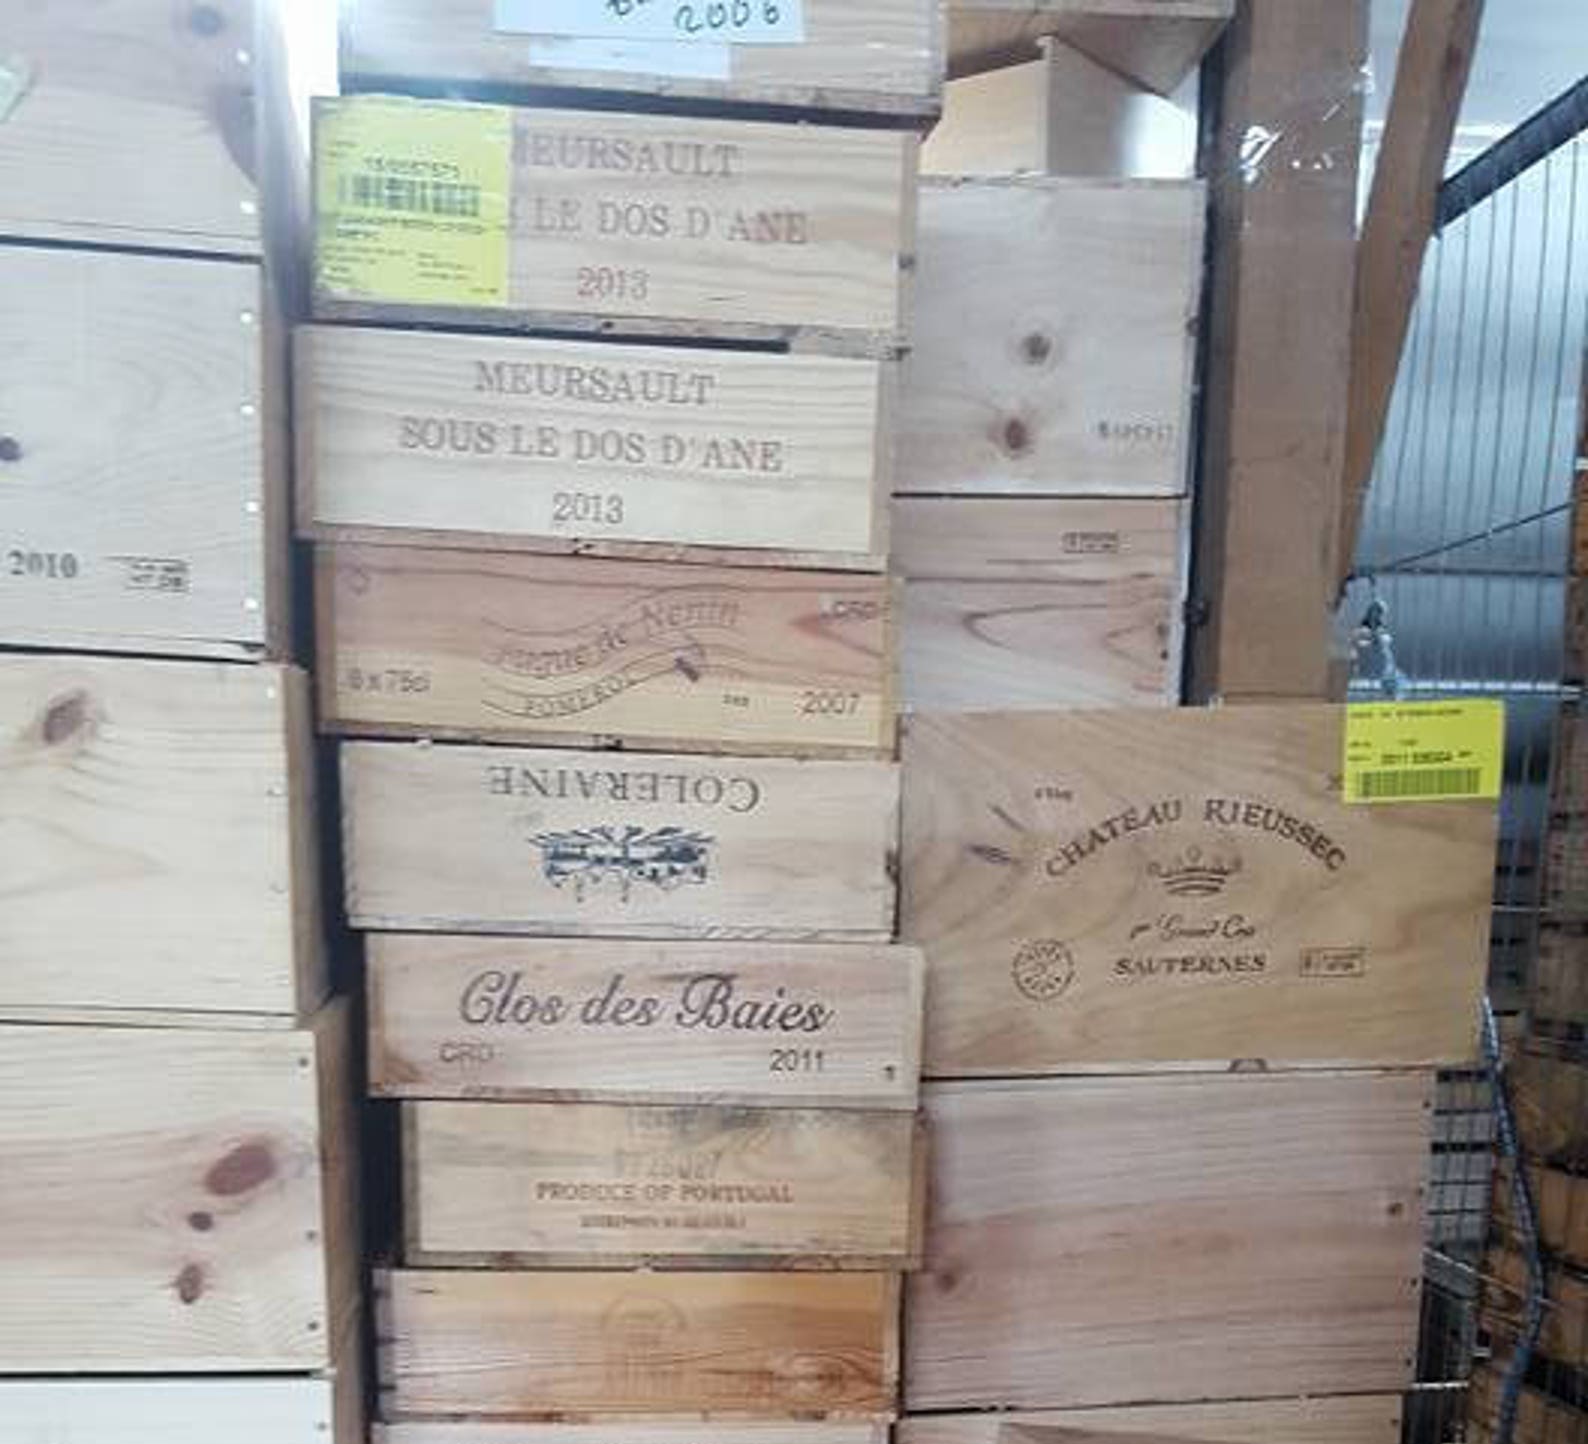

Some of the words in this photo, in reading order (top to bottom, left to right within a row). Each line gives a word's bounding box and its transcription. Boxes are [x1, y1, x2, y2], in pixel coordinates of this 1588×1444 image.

[533, 197, 582, 232] LE
[599, 202, 671, 238] DOS
[577, 266, 650, 301] 2013
[475, 359, 716, 406] MEURSAULT
[401, 416, 498, 453] SOUS
[506, 424, 560, 458] LE
[572, 428, 647, 465] DOS
[659, 434, 783, 473] D'ANE
[552, 490, 625, 525] 2013
[7, 549, 79, 579] 2010
[802, 689, 861, 714] 2007
[485, 764, 761, 812] COLERAINE
[1045, 798, 1183, 878] CHATEAU
[1202, 798, 1347, 871] RIEUSSEC
[1113, 953, 1266, 976] SAUTERNES
[457, 970, 568, 1026] Clos
[580, 974, 663, 1027] des
[674, 971, 834, 1033] Baies
[769, 1048, 824, 1072] 2011
[535, 1180, 636, 1202] PRODUCE
[645, 1181, 674, 1202] OF
[678, 1181, 795, 1204] PORTUGAL
